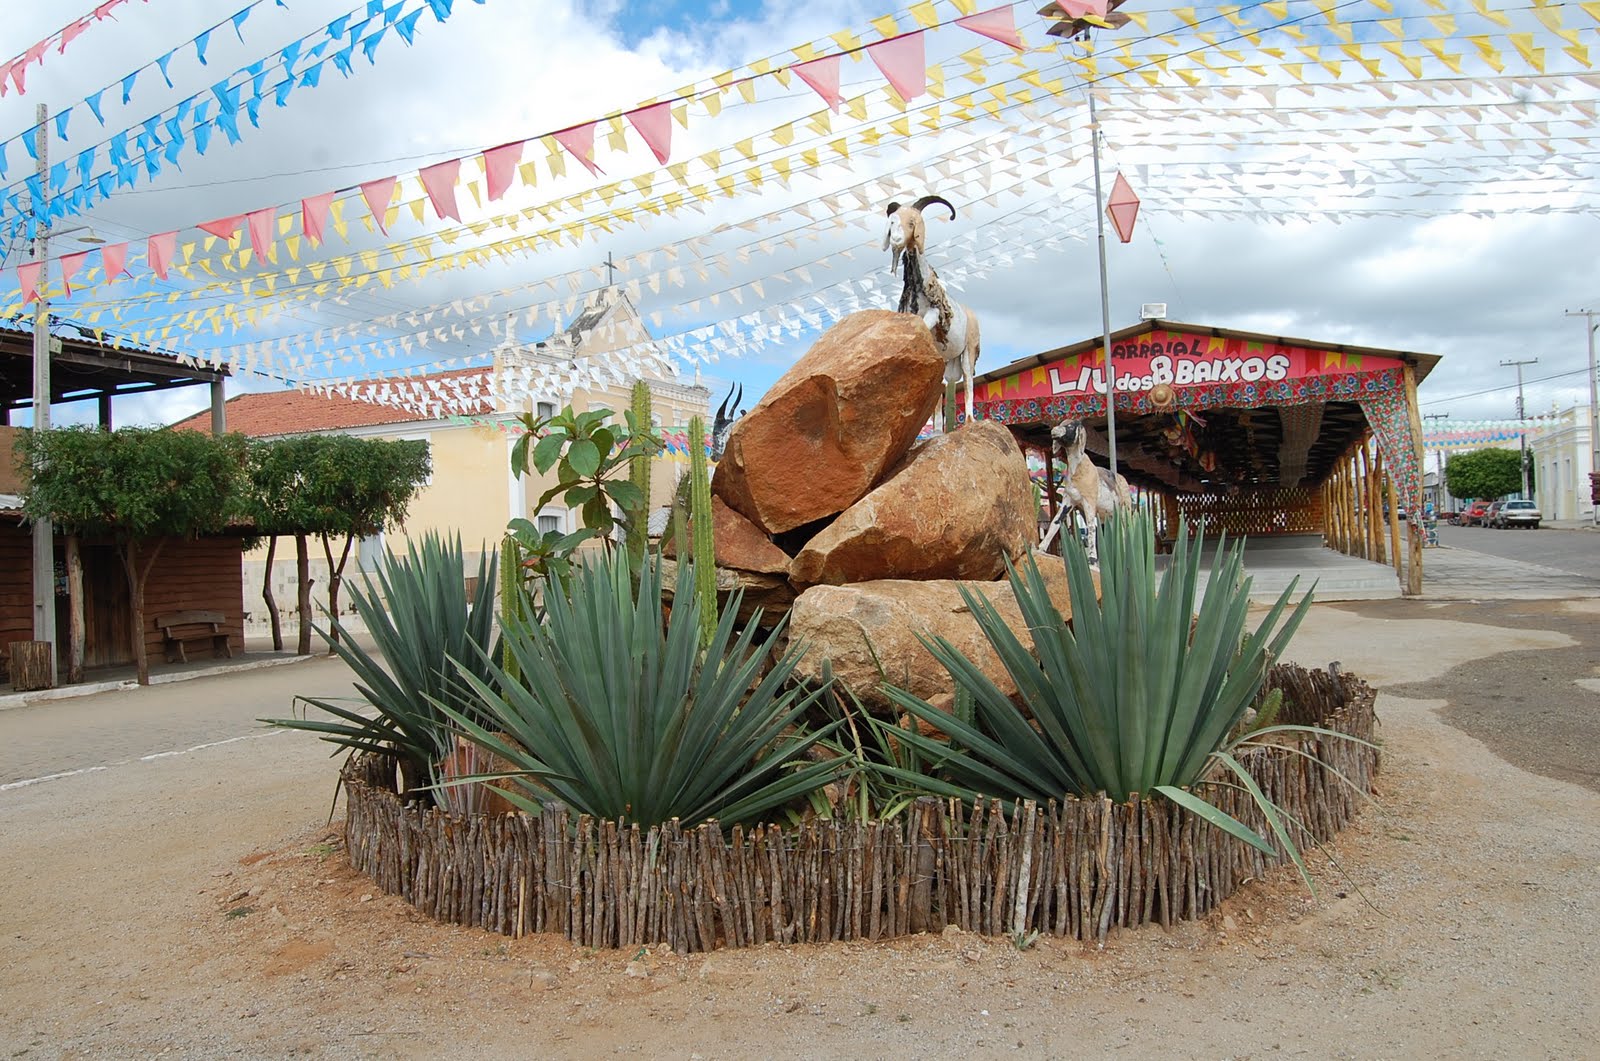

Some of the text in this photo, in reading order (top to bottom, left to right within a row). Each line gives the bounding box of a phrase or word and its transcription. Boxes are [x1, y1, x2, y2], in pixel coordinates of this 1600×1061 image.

[1112, 339, 1203, 359] ARRAIAL
[1116, 372, 1153, 392] dos
[1150, 355, 1175, 385] 8
[1174, 354, 1290, 385] BAIXOS
